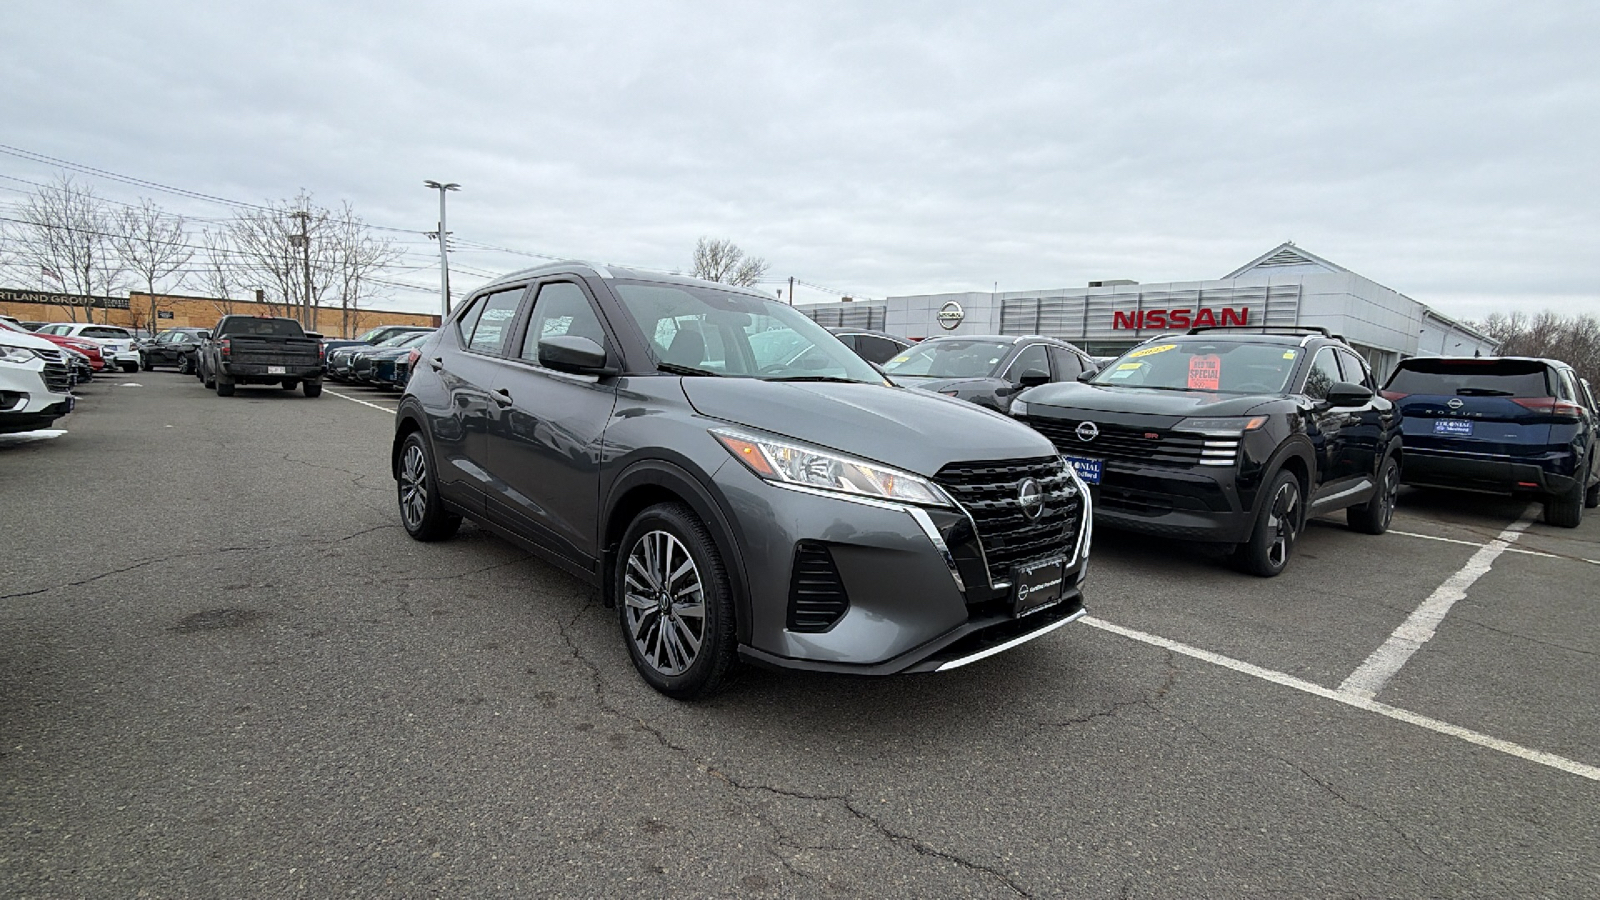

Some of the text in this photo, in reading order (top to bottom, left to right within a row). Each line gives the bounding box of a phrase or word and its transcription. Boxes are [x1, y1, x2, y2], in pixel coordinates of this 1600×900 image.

[1113, 307, 1249, 330] NISSAN
[1189, 369, 1219, 379] SPECIAL
[1425, 409, 1482, 417] ROGUE
